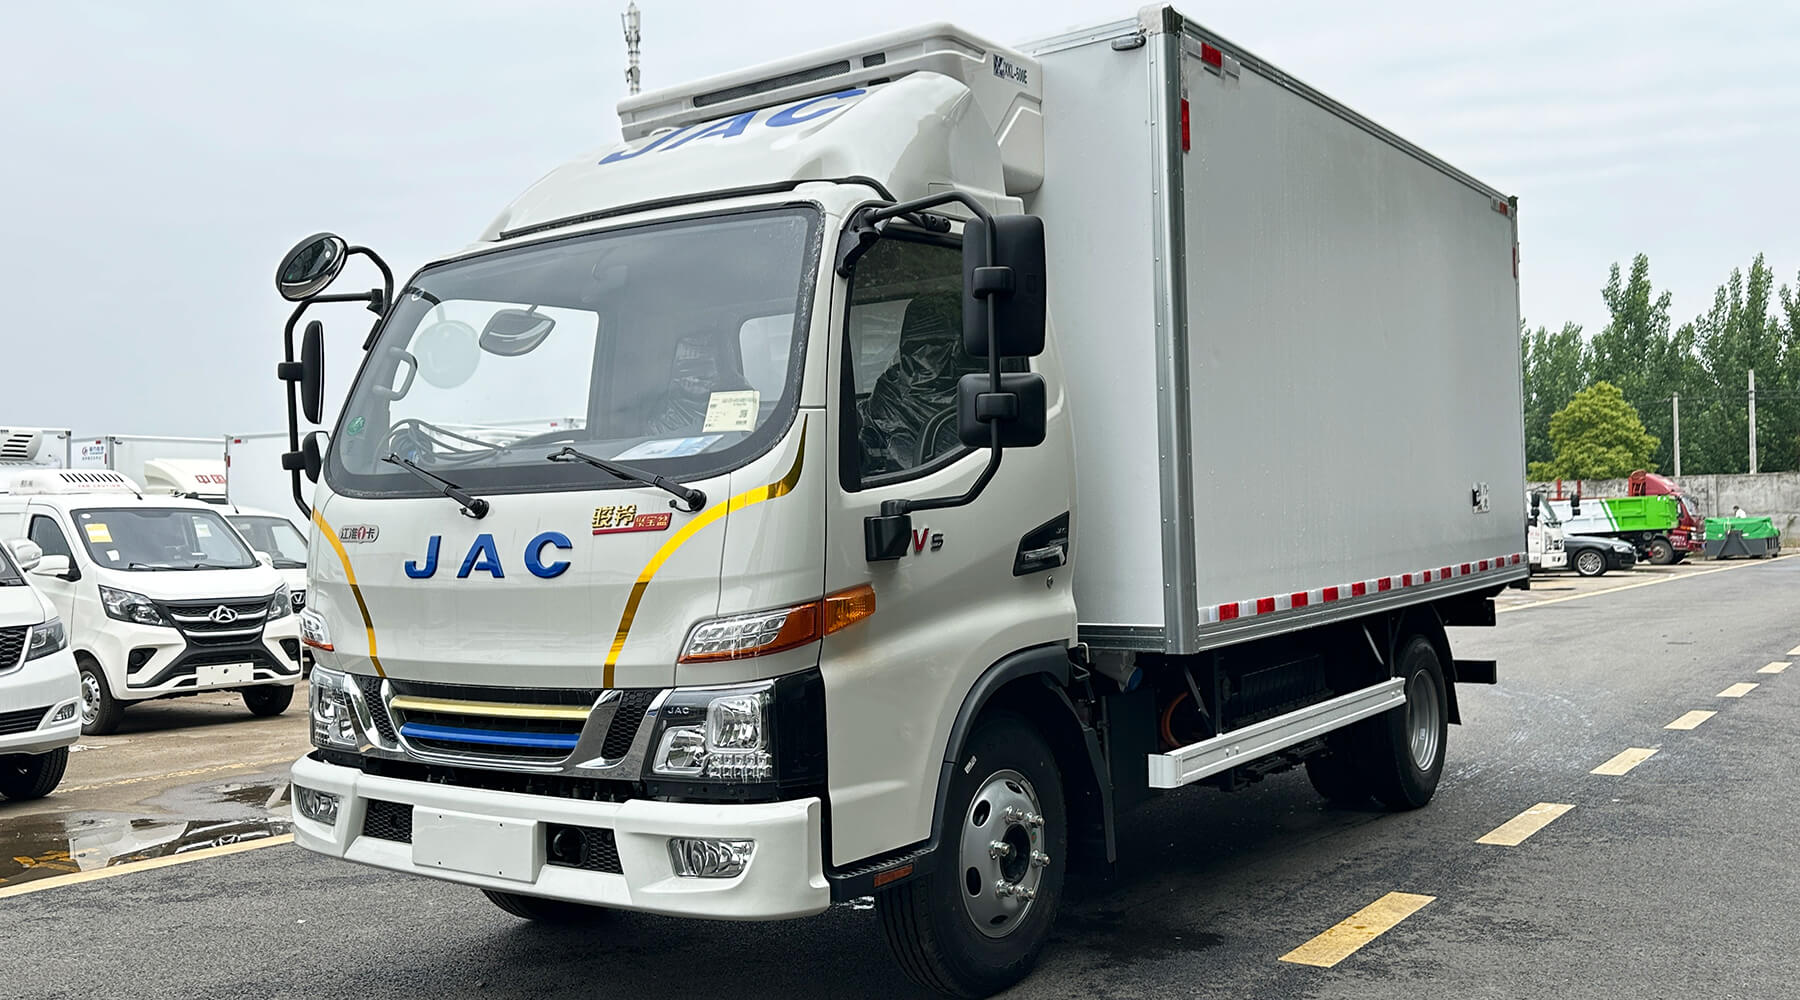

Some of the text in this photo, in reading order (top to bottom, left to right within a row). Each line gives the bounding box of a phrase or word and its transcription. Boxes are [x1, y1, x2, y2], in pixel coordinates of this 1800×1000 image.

[598, 88, 867, 165] JAC
[404, 531, 573, 579] JAC
[667, 706, 690, 715] JAC
